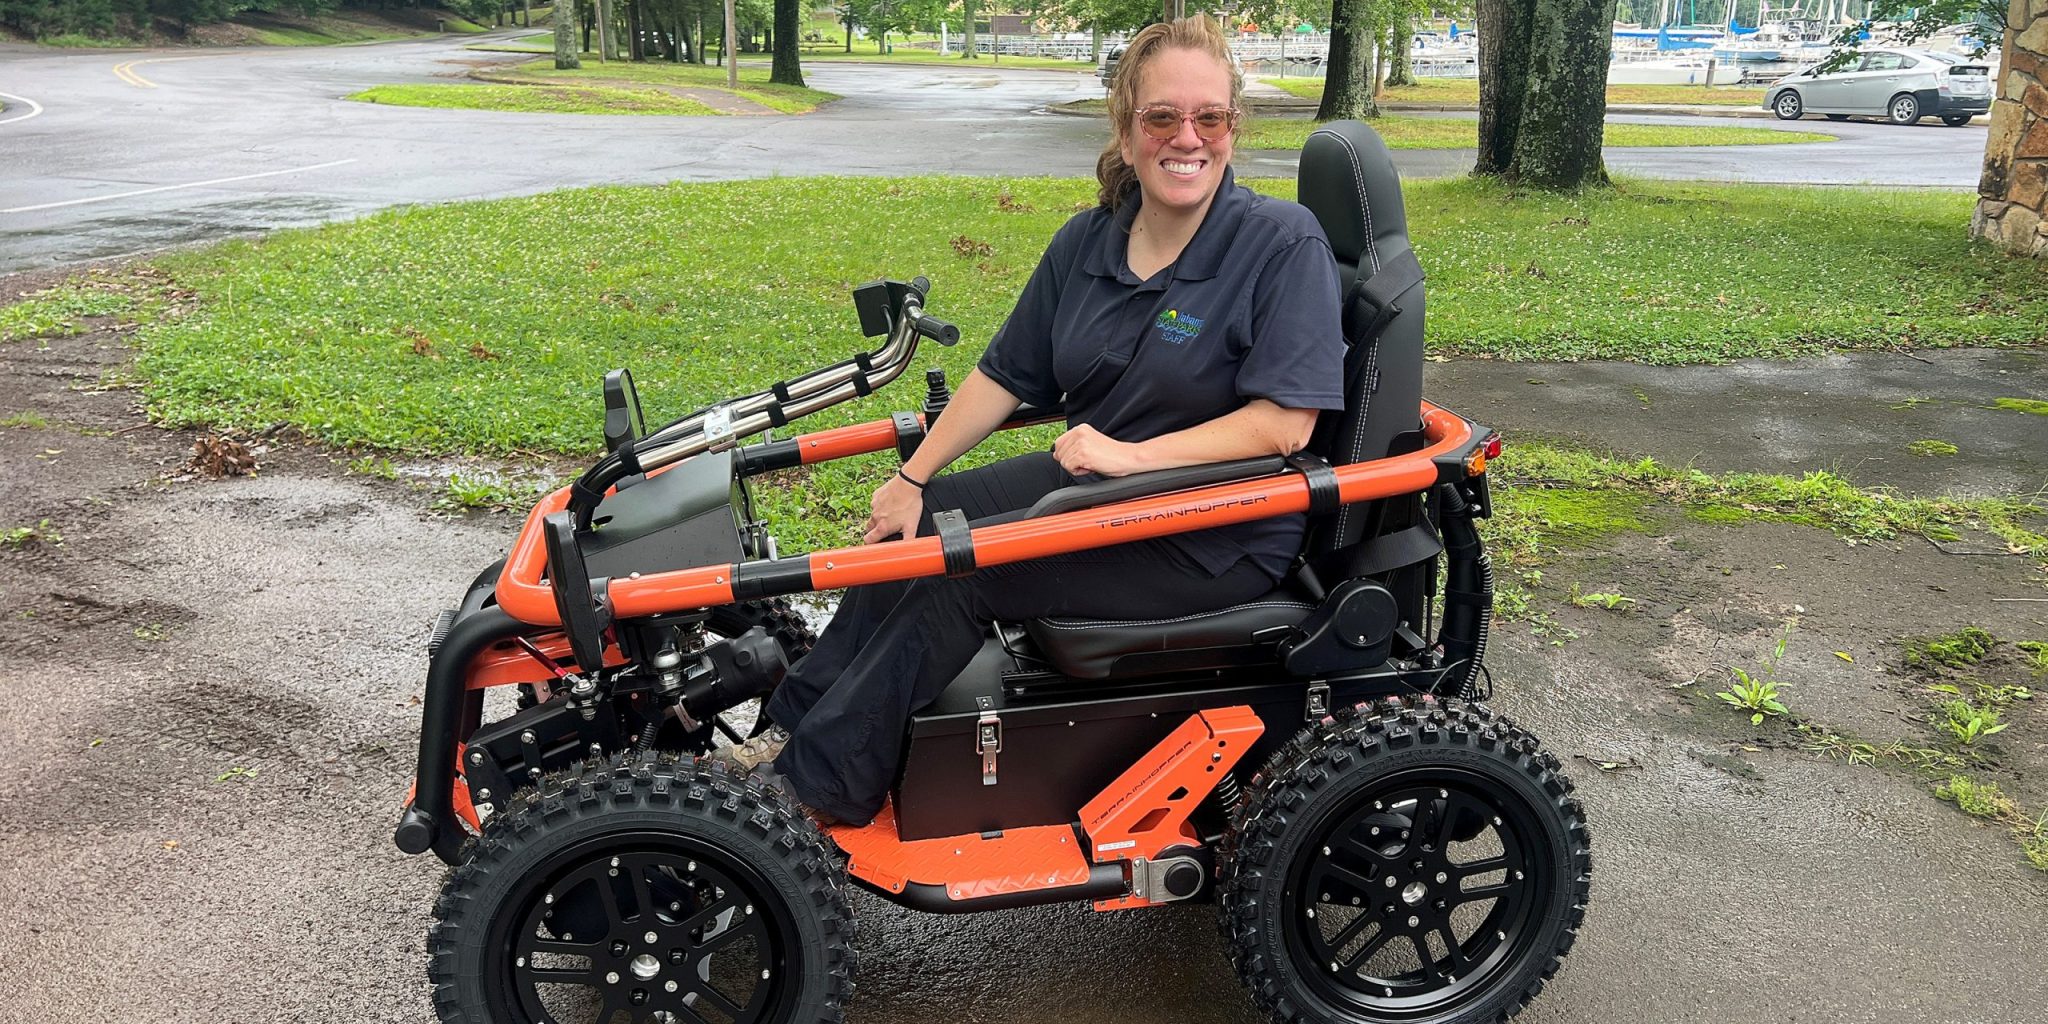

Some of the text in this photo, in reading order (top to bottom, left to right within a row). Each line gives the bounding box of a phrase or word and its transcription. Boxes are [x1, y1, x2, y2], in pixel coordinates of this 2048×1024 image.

[1161, 331, 1186, 344] STAFF
[1095, 494, 1268, 529] TERRAINHOPPER
[1091, 740, 1192, 825] TERRAINHOPPER
